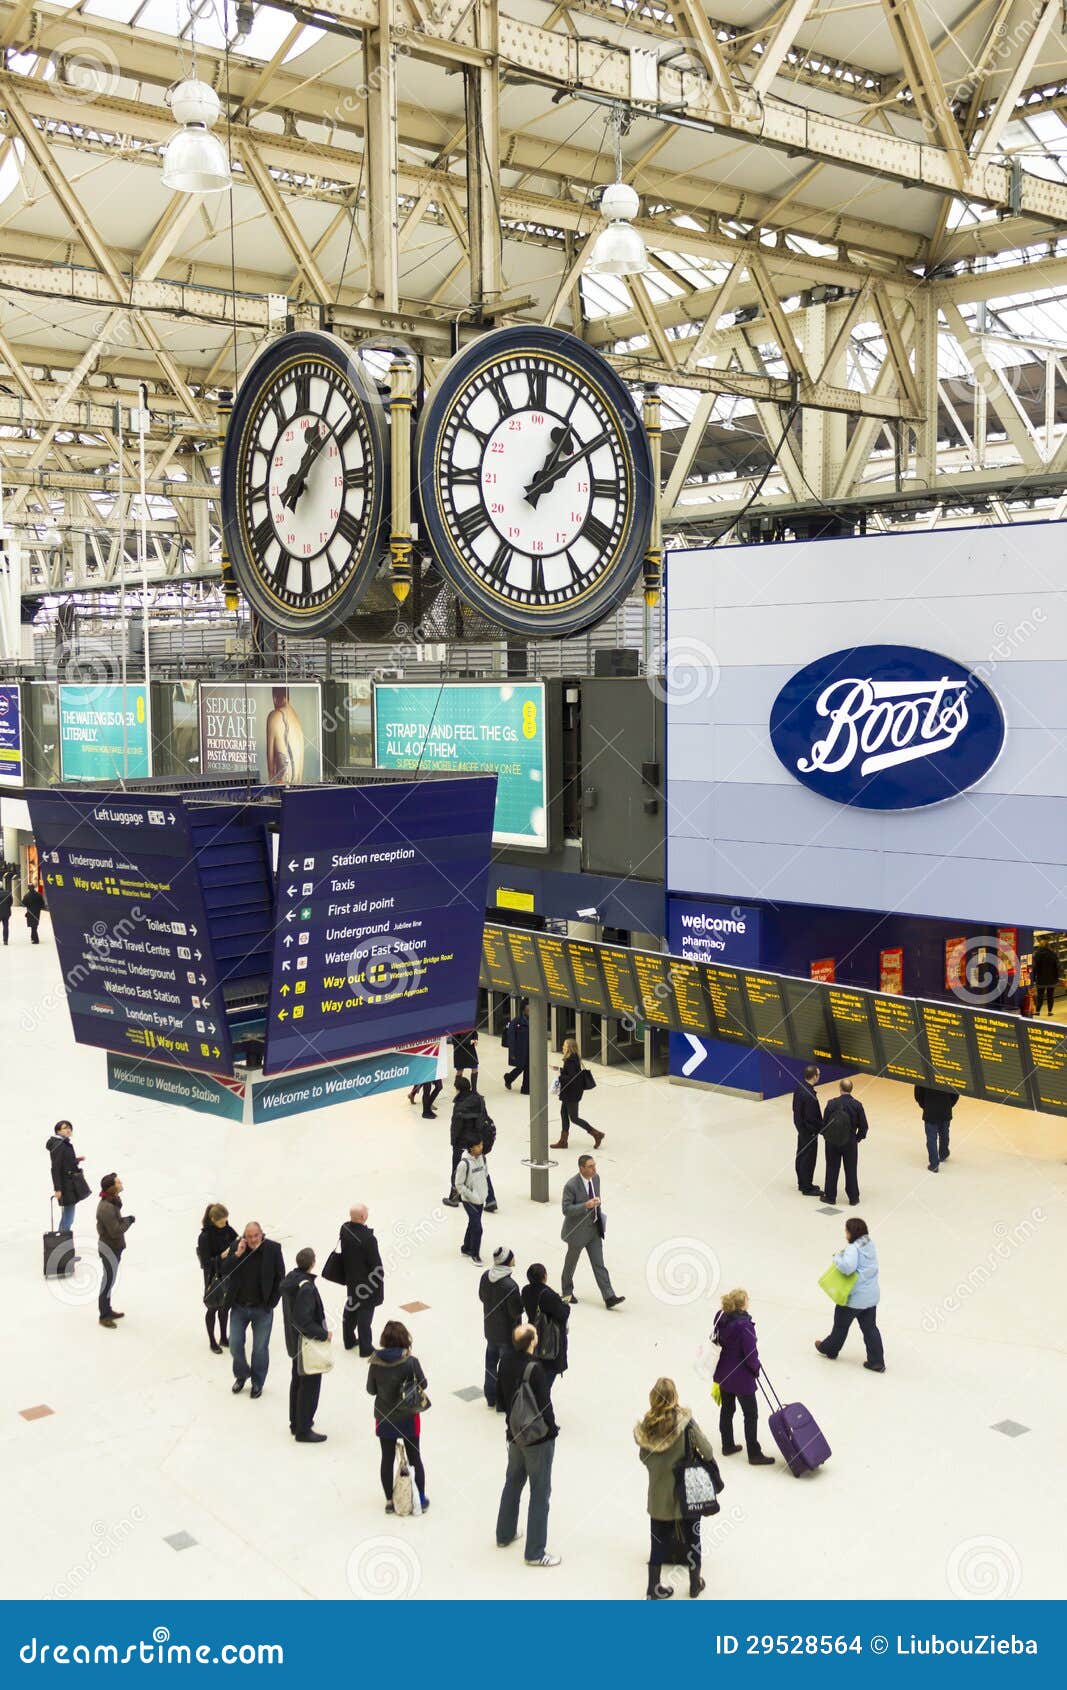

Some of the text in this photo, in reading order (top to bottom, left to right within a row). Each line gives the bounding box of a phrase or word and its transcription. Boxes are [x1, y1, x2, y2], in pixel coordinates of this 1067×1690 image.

[508, 420, 521, 431] 23
[532, 415, 544, 425] 00
[285, 431, 294, 442] 23
[491, 443, 504, 453] 22
[274, 456, 283, 467] 22
[334, 476, 343, 487] 15
[485, 473, 497, 484] 21
[577, 482, 588, 493] 15
[330, 508, 339, 520] 16
[491, 503, 504, 513] 20
[275, 513, 284, 523] 20
[570, 511, 582, 523] 16
[287, 534, 295, 544] 19
[319, 532, 328, 543] 17
[508, 527, 520, 538] 19
[555, 532, 567, 544] 17
[303, 543, 312, 554] 18
[532, 540, 544, 551] 18
[206, 697, 256, 714] SEDUCED
[62, 711, 78, 724] THE
[78, 711, 107, 725] WAITING
[207, 715, 256, 738] BY ART
[385, 723, 417, 738] STRAP
[418, 724, 429, 738] IN
[429, 725, 454, 739] AND
[454, 725, 478, 740] FEEL
[480, 725, 501, 741] THE
[796, 676, 969, 776] Boots
[62, 727, 98, 742] LITERALLY.
[207, 738, 256, 751] PHOTOGRAPHY
[386, 741, 459, 758] ALL 4 OF THEM.
[207, 750, 220, 761] PAST
[228, 751, 256, 763] PRESENT
[94, 808, 144, 825] Left Luggage
[69, 853, 113, 870] Underground
[331, 848, 415, 867] Station reception
[73, 876, 103, 891] Way out
[331, 879, 355, 892] Taxis
[328, 897, 395, 917] First aid point
[146, 918, 172, 933] Toilets
[326, 920, 423, 941] Underground Jubilee line
[682, 914, 746, 934] welcome
[83, 933, 171, 957] Tickets and Travel Centre
[682, 935, 726, 951] pharmacy
[325, 939, 427, 965] Waterloo East Station
[682, 949, 711, 962] beauty
[128, 963, 176, 981] Underground
[323, 972, 366, 990] Way out
[104, 980, 181, 1005] Waterloo East Station
[321, 996, 363, 1014] Way out
[125, 1007, 184, 1029] London Eye Pier
[157, 1035, 174, 1051] Way
[175, 1040, 190, 1052] out
[113, 1067, 220, 1104] Welcome to Waterloo Station
[262, 1065, 410, 1109] Welcome to Waterloo Station
